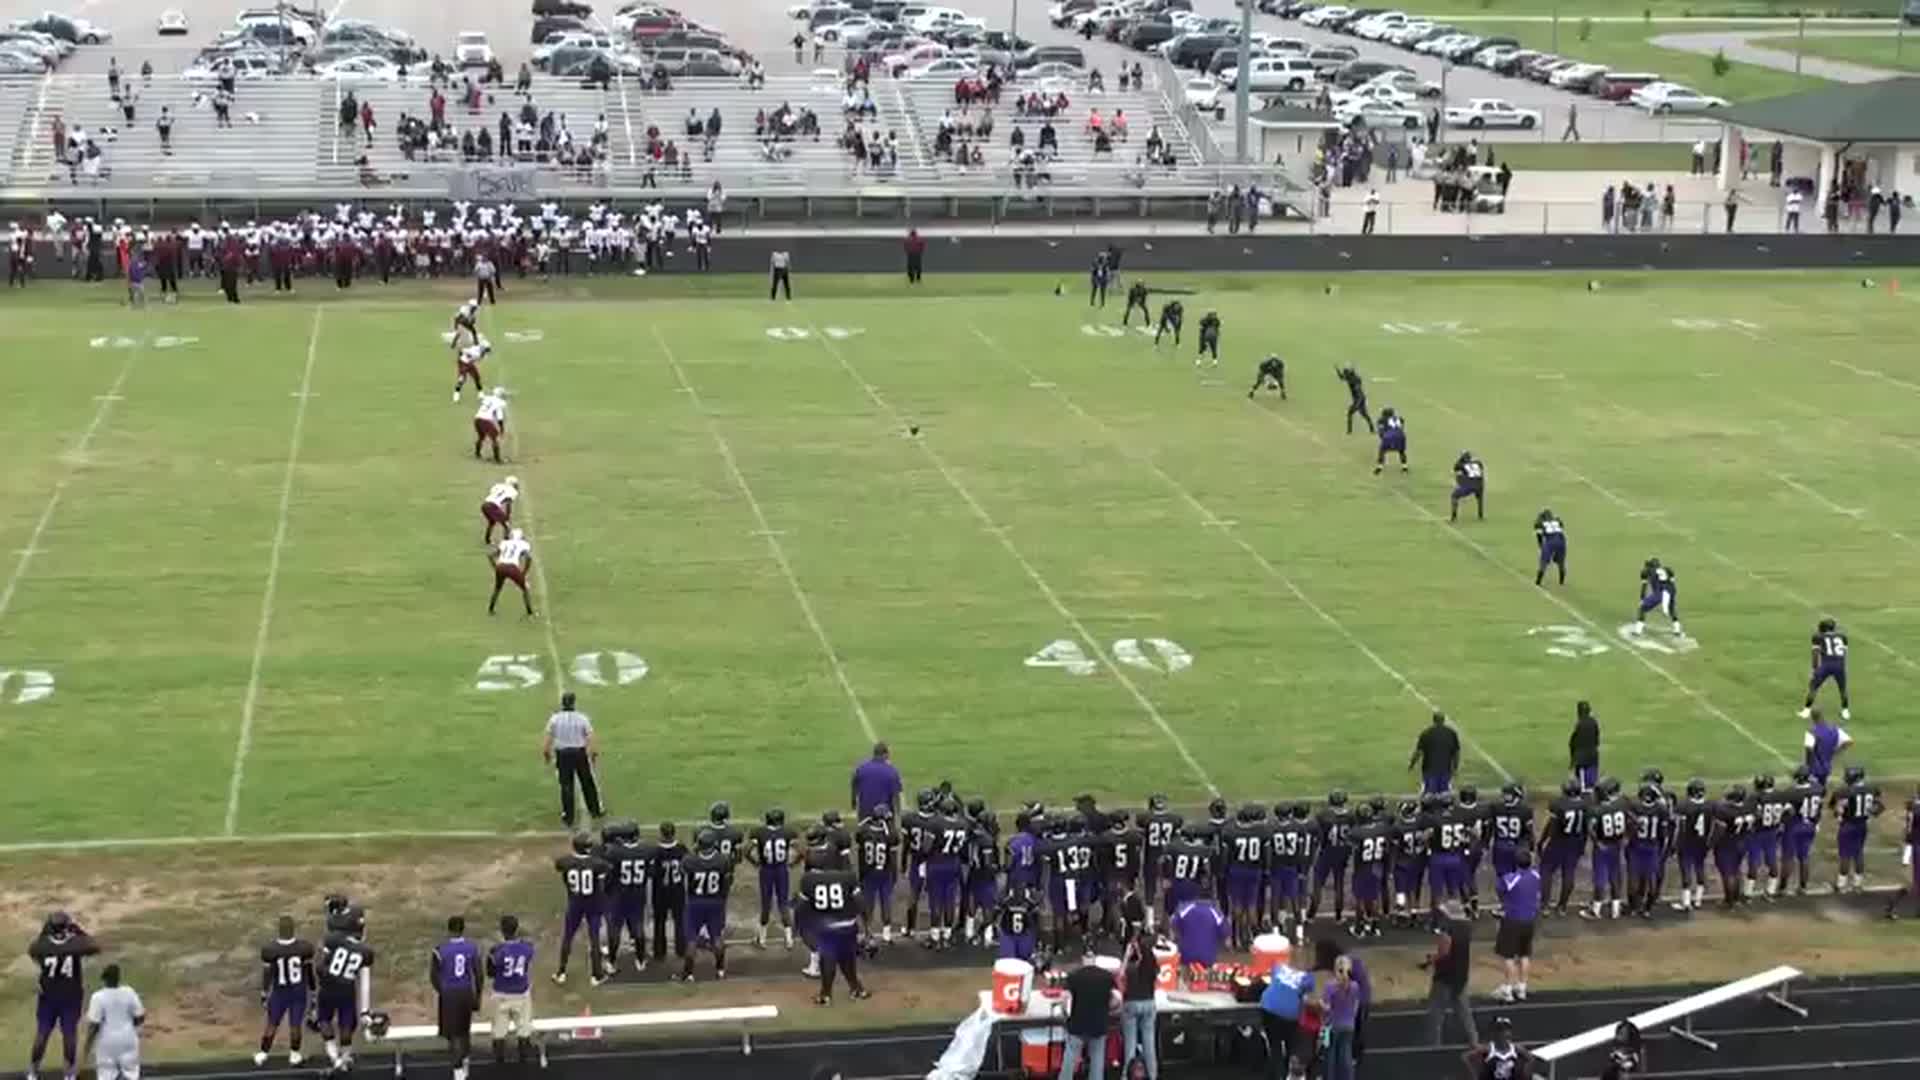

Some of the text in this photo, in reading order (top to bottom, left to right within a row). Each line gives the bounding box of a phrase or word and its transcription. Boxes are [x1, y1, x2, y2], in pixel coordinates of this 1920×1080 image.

[1024, 638, 1193, 675] 40
[1825, 636, 1845, 656] 12
[475, 650, 650, 690] 50
[1149, 822, 1173, 846] 23
[1441, 823, 1464, 848] 65
[1496, 815, 1520, 838] 59
[1602, 811, 1625, 837] 89
[1637, 815, 1658, 839] 31
[763, 839, 786, 863] 46
[864, 841, 886, 865] 86
[942, 829, 966, 853] 73
[1236, 836, 1260, 861] 70
[1114, 843, 1128, 867] 5
[1175, 853, 1199, 878] 81
[567, 868, 593, 895] 90
[620, 860, 645, 885] 55
[695, 871, 720, 895] 78
[814, 883, 844, 909] 99
[1012, 912, 1023, 933] 6
[44, 956, 73, 978] 74
[277, 956, 301, 985] 16
[328, 947, 362, 979] 82
[454, 953, 465, 977] 8
[503, 955, 525, 977] 34
[1004, 982, 1020, 1000] G
